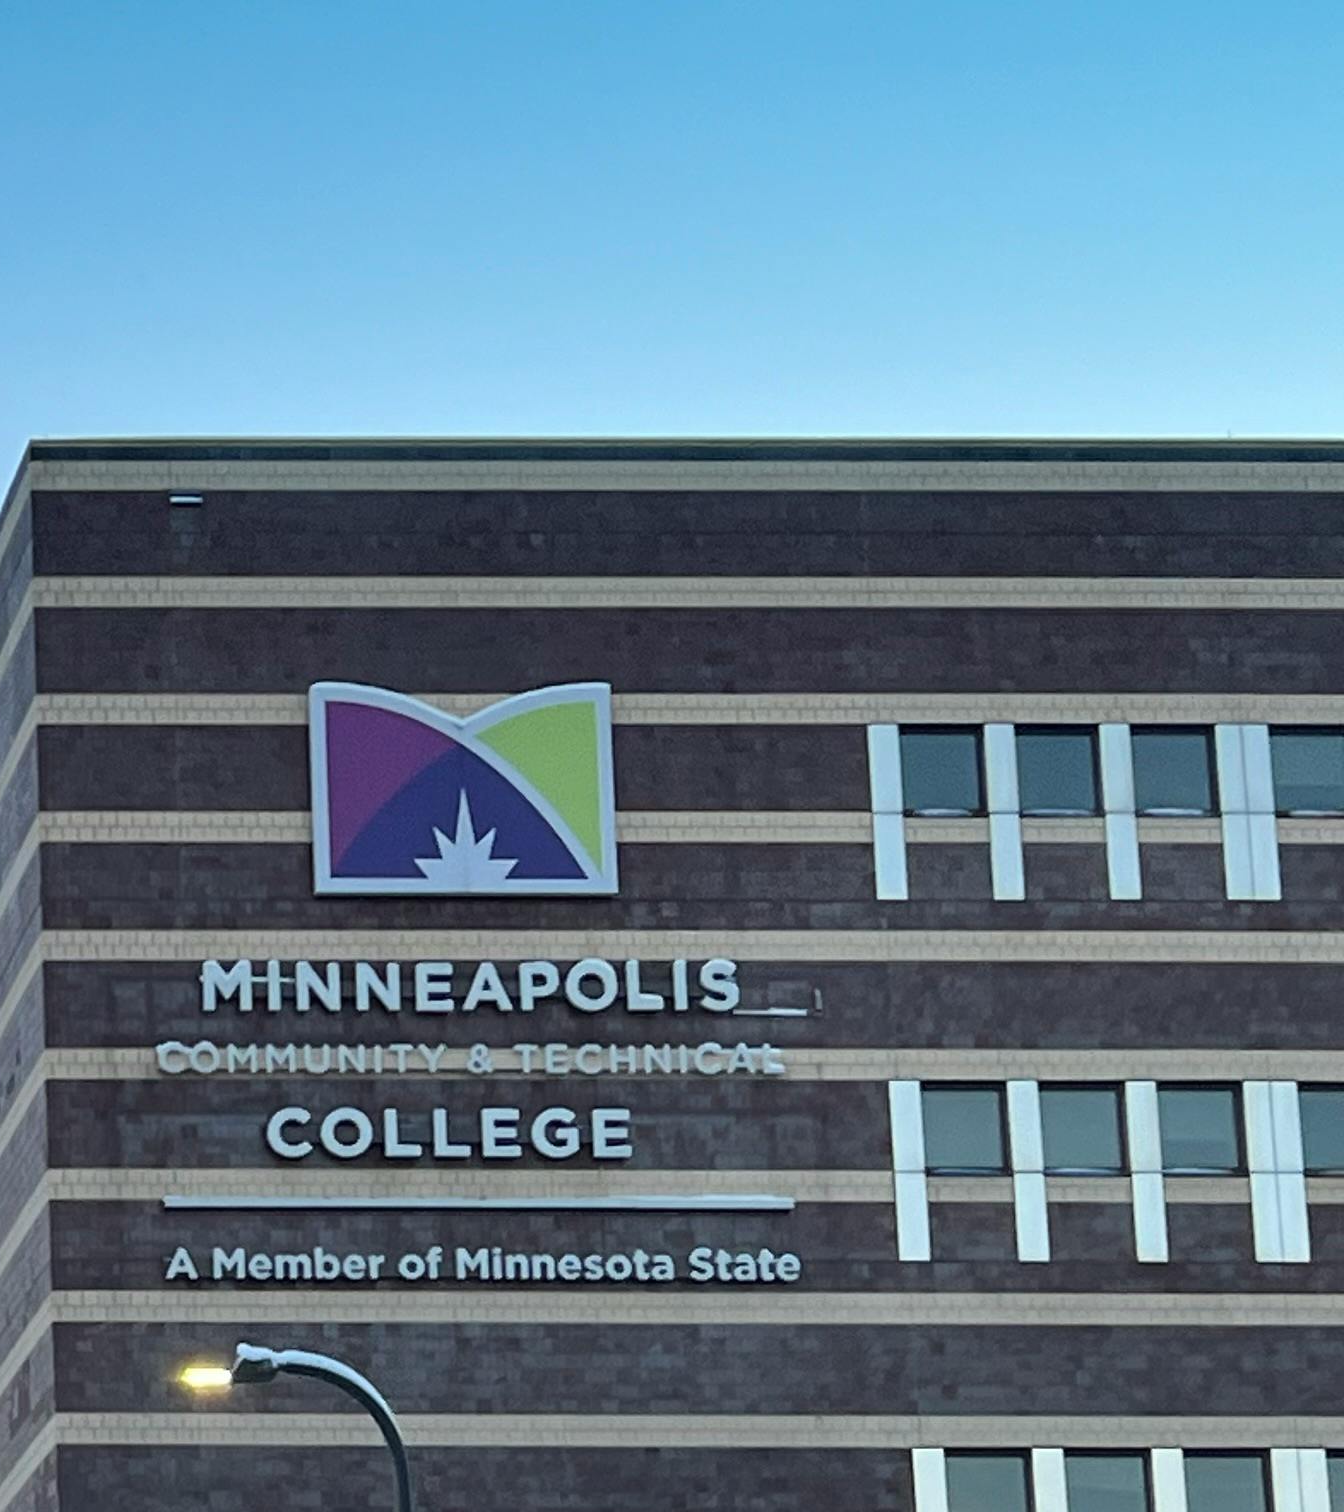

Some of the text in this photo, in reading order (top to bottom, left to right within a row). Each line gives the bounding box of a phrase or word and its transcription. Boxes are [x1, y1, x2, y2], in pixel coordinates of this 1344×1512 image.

[201, 957, 741, 1013] MINNEAPOLIS
[156, 1040, 787, 1076] COMMUNITY & TECHNICAL
[266, 1106, 634, 1159] COLLEGE
[165, 1246, 802, 1282] A Member of Minnesota State
